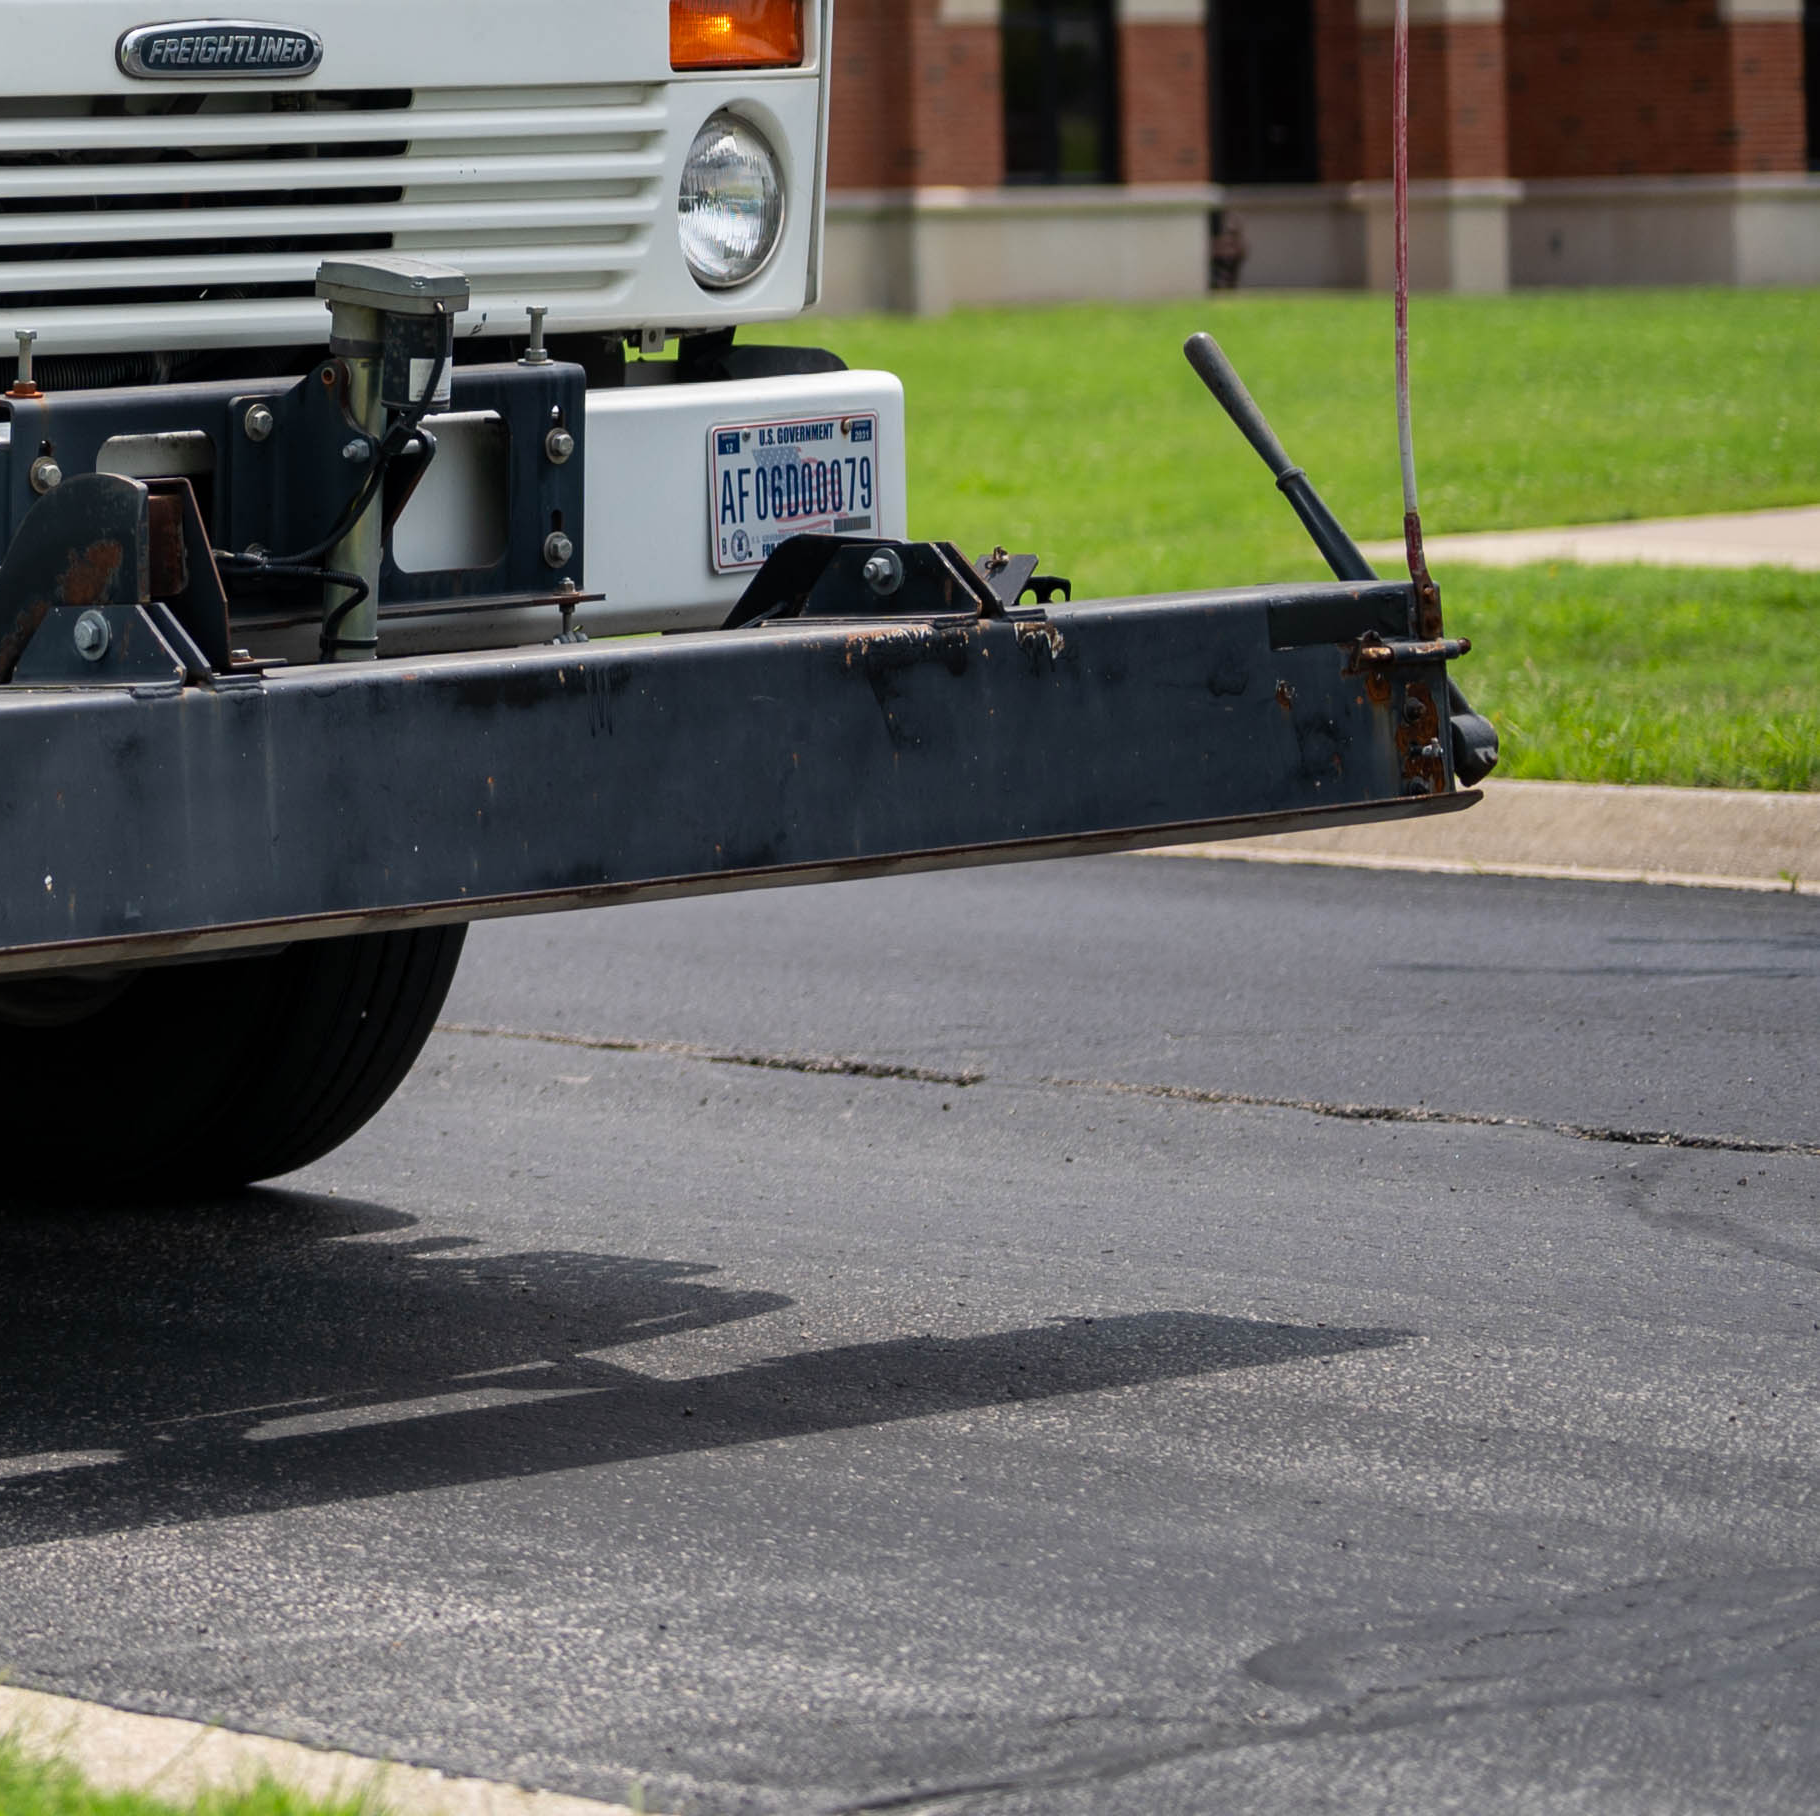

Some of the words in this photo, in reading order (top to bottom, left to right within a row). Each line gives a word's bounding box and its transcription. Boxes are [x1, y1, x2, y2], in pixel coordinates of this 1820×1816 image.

[148, 35, 307, 65] FREIGHTLINER
[758, 429, 776, 447] U.S.
[777, 422, 835, 445] GOVERNMENT
